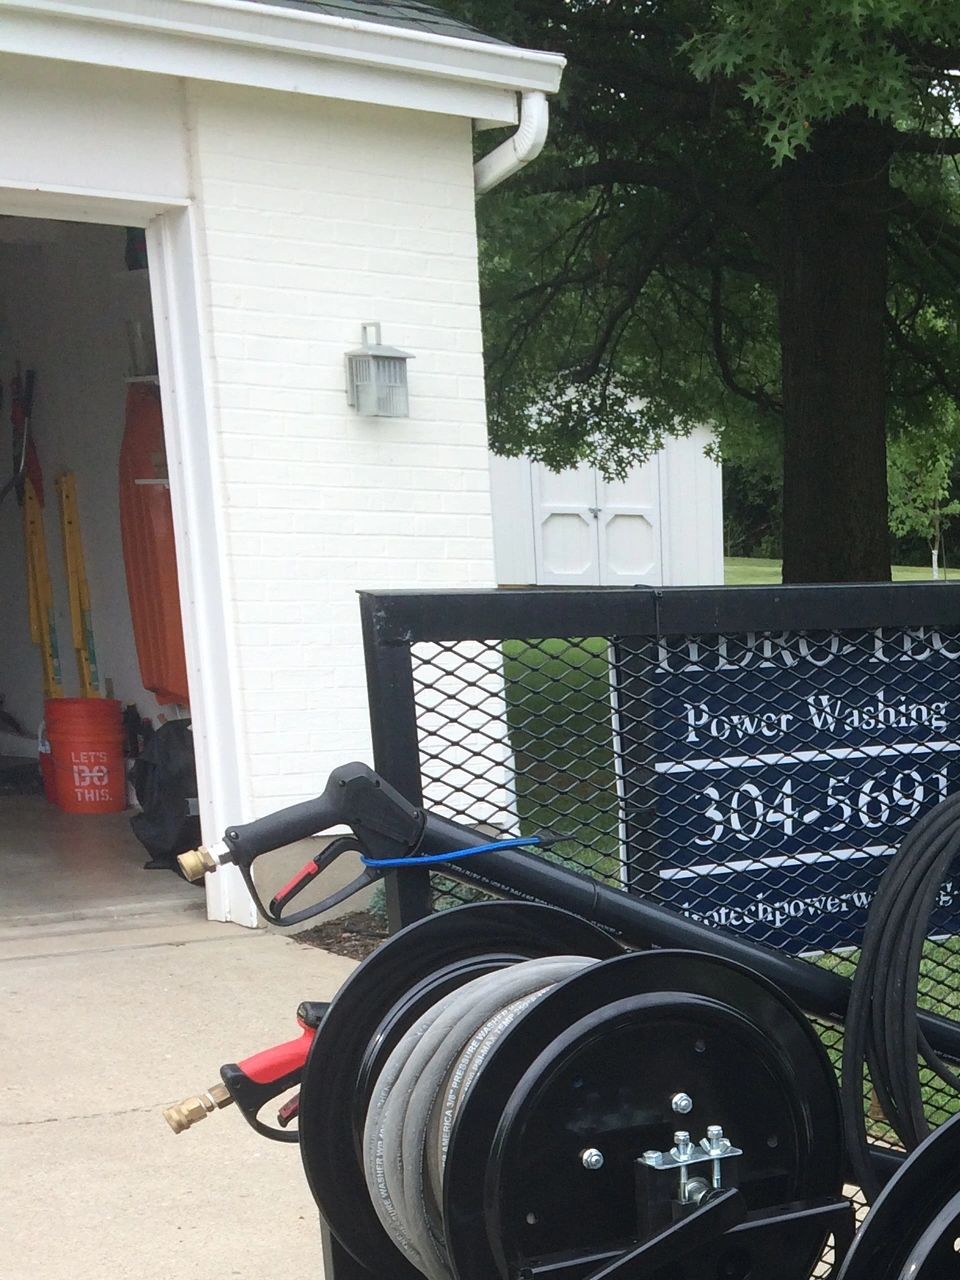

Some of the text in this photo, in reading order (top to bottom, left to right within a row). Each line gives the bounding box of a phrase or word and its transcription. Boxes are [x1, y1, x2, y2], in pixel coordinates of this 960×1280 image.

[683, 691, 950, 742] Power Washing
[71, 751, 107, 762] LET'S
[73, 765, 109, 786] DO
[75, 789, 113, 801] THIS.
[694, 768, 950, 846] 304-5691
[452, 1040, 478, 1089] PRESSURE
